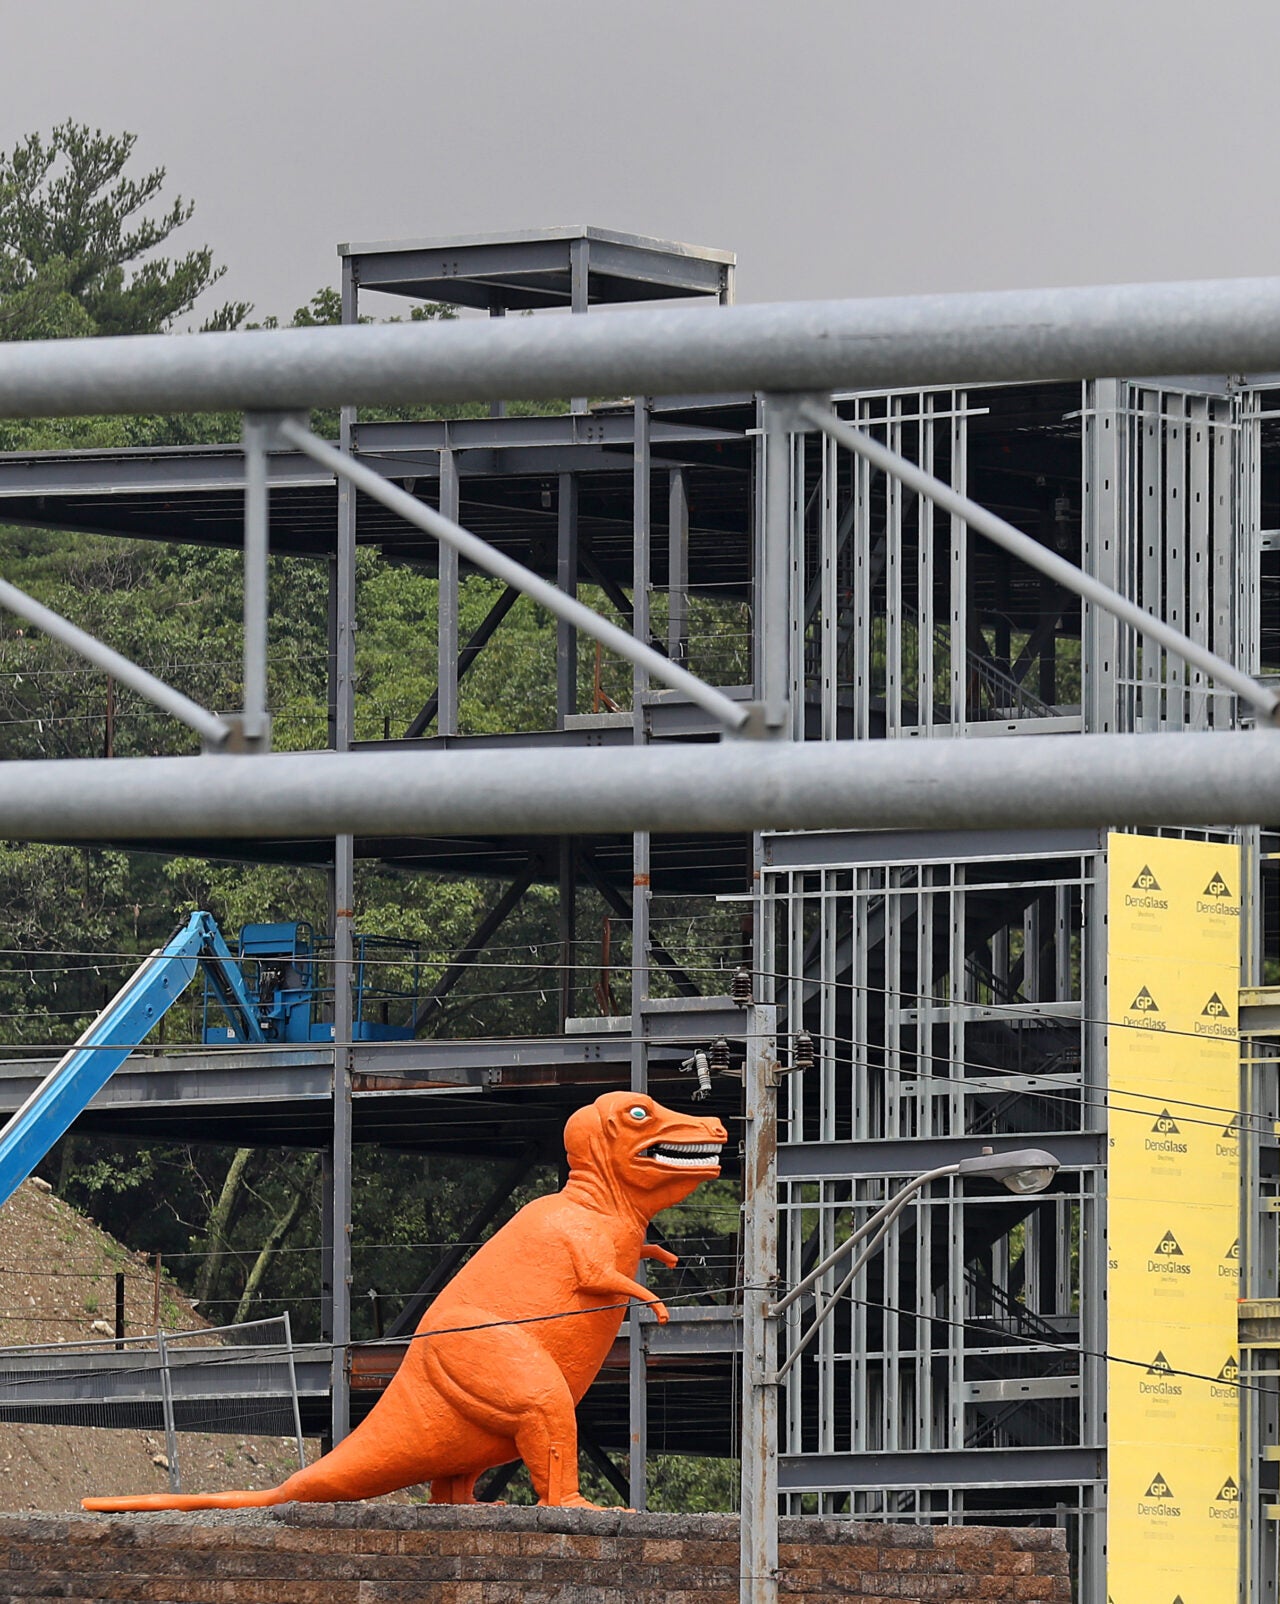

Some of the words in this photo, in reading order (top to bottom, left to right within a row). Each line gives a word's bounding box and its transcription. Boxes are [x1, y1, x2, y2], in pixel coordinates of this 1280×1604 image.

[1137, 874, 1154, 888] GP
[1209, 882, 1225, 895] GP
[1125, 894, 1168, 910] DensGlass
[1136, 996, 1152, 1009] GP
[1207, 1001, 1223, 1015] GP
[1194, 1021, 1237, 1036] DensGlass
[1157, 1118, 1173, 1132] GP
[1145, 1138, 1187, 1153] DensGlass
[1160, 1240, 1177, 1254] GP
[1147, 1260, 1191, 1274] DensGlass
[1139, 1381, 1182, 1395] DensGlass
[1150, 1483, 1167, 1496] GP
[1221, 1486, 1238, 1500] GP
[1137, 1503, 1181, 1517] DensGlass
